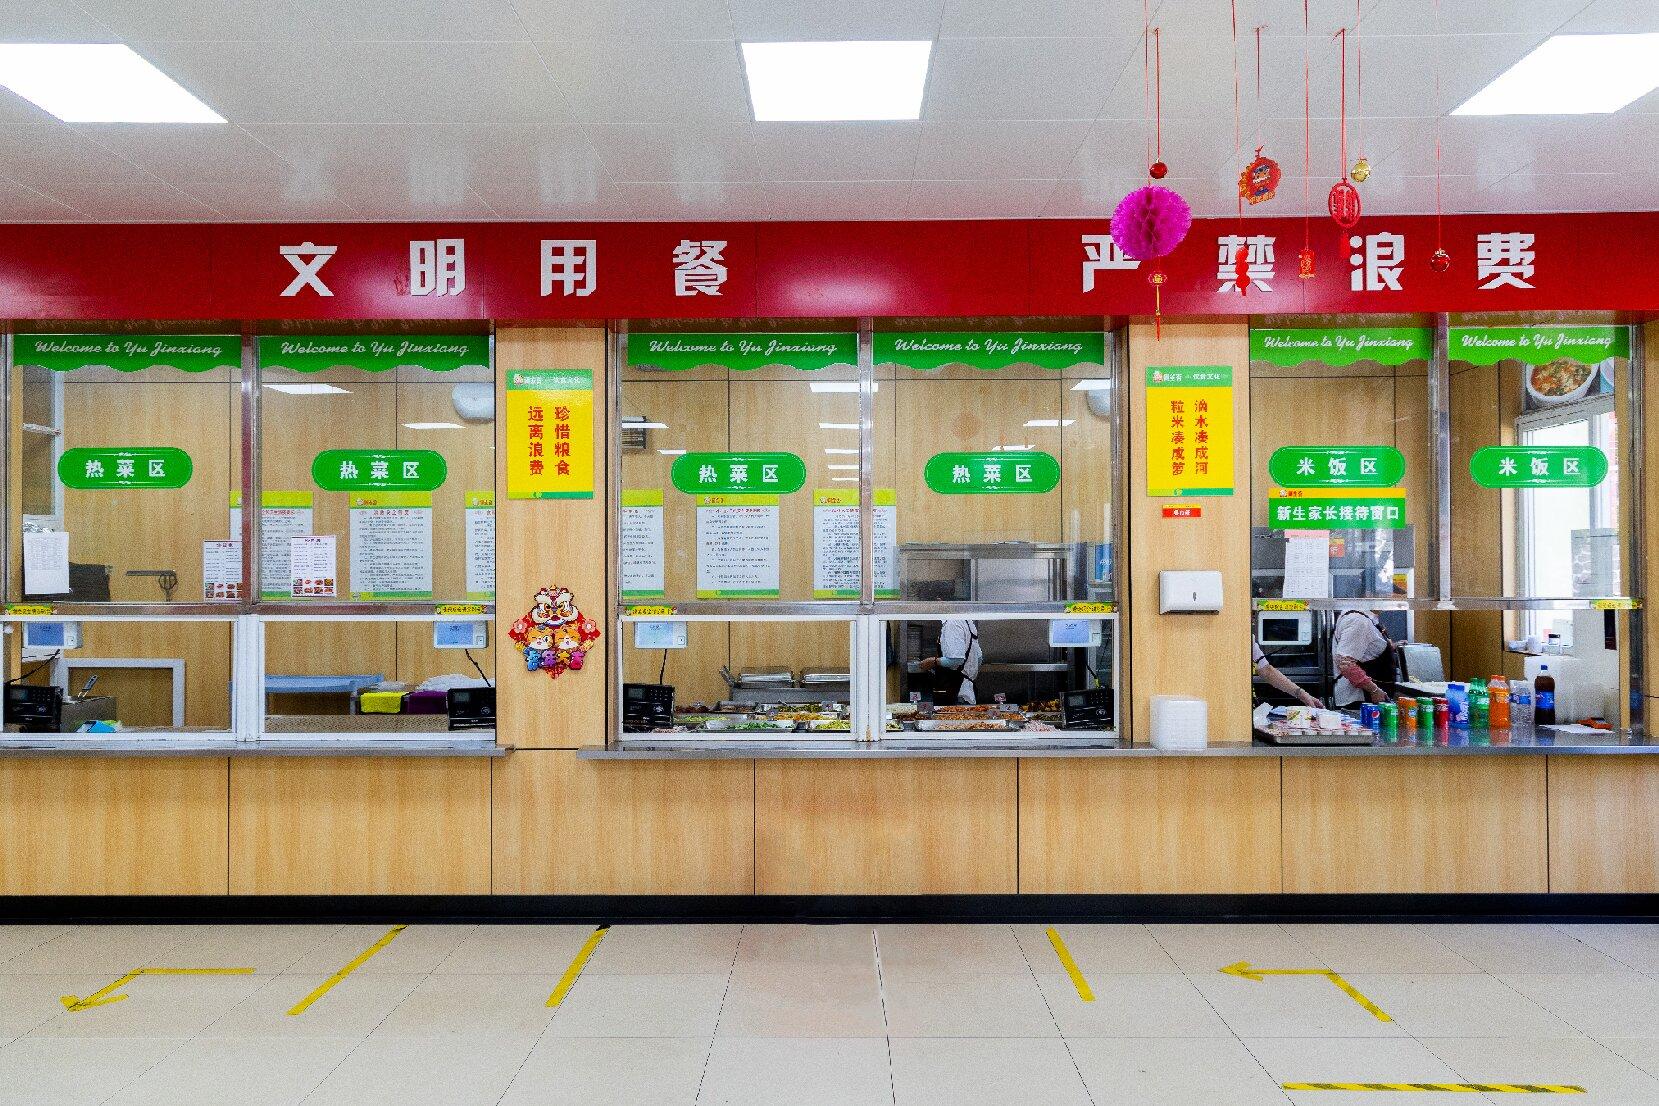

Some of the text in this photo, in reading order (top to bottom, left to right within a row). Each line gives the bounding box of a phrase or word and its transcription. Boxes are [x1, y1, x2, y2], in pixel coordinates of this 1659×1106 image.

[279, 231, 1537, 297] 文明用餐 严禁浪费
[34, 340, 222, 357] Welcome to Yu Jinxiang
[281, 341, 470, 357] Welcome to Yu Jinxiang
[649, 339, 838, 356] Welcome to Yu Jinxiang
[894, 337, 1083, 354] Welcome to Yu Jinxiang
[1264, 335, 1414, 351] Welcome to Yu Jinxiang
[1461, 333, 1613, 350] Welcome to Yu Jinxiang
[528, 405, 545, 476] 远离浪费
[554, 405, 571, 476] 珍惜粮食
[1194, 399, 1209, 475] 滴水凑成河
[85, 459, 166, 478] 热菜区
[339, 460, 420, 480] 热菜区
[698, 464, 779, 483] 热菜区
[952, 464, 1033, 483] 热菜区
[1296, 457, 1379, 476] 米饭区
[1498, 457, 1582, 476] 米饭区
[1276, 505, 1400, 521] 新生家长接待窗口
